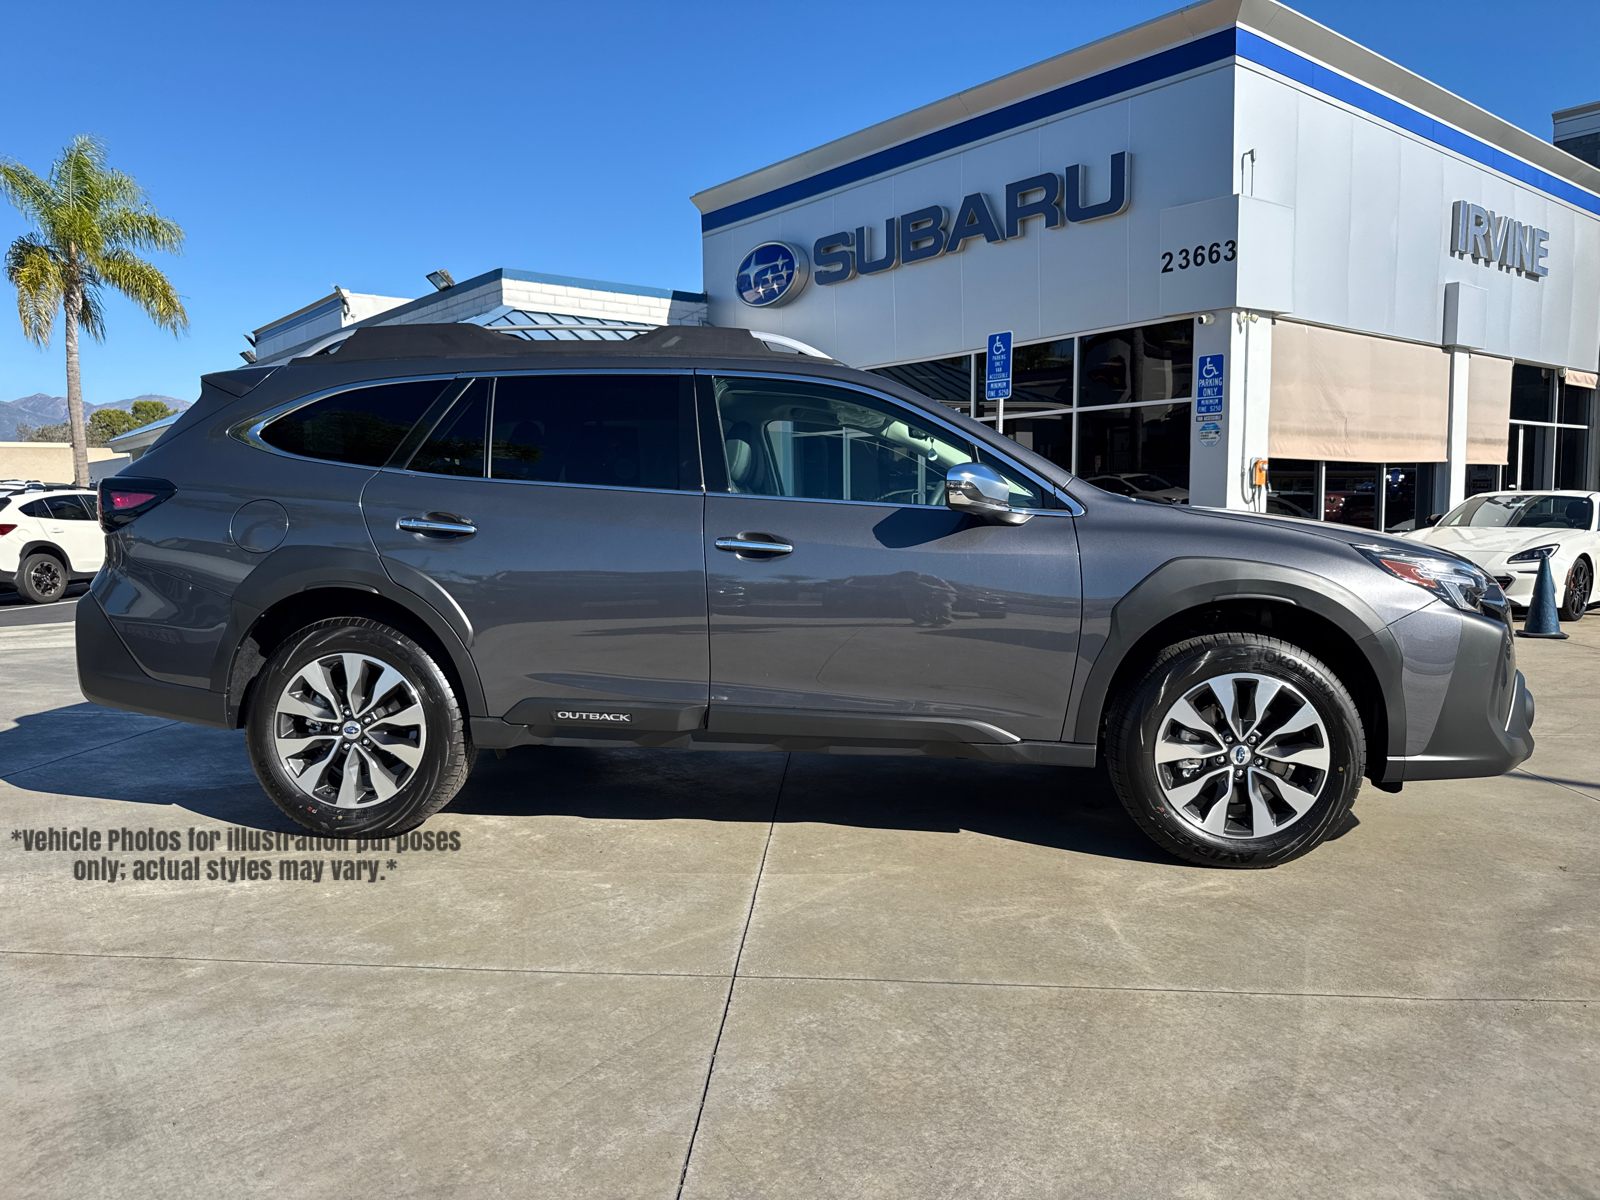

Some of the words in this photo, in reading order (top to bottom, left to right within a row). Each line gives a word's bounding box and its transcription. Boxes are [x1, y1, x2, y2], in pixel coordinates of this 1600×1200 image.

[813, 151, 1132, 286] SUBARU
[1450, 200, 1549, 277] IRVINE
[1161, 239, 1237, 274] 23663
[990, 381, 1006, 389] MINIMUM
[1198, 377, 1222, 388] PARKING
[998, 389, 1009, 397] $250
[1203, 387, 1218, 397] ONLY
[1254, 648, 1335, 704] YOKOHAMA
[557, 711, 631, 722] OUTBACK
